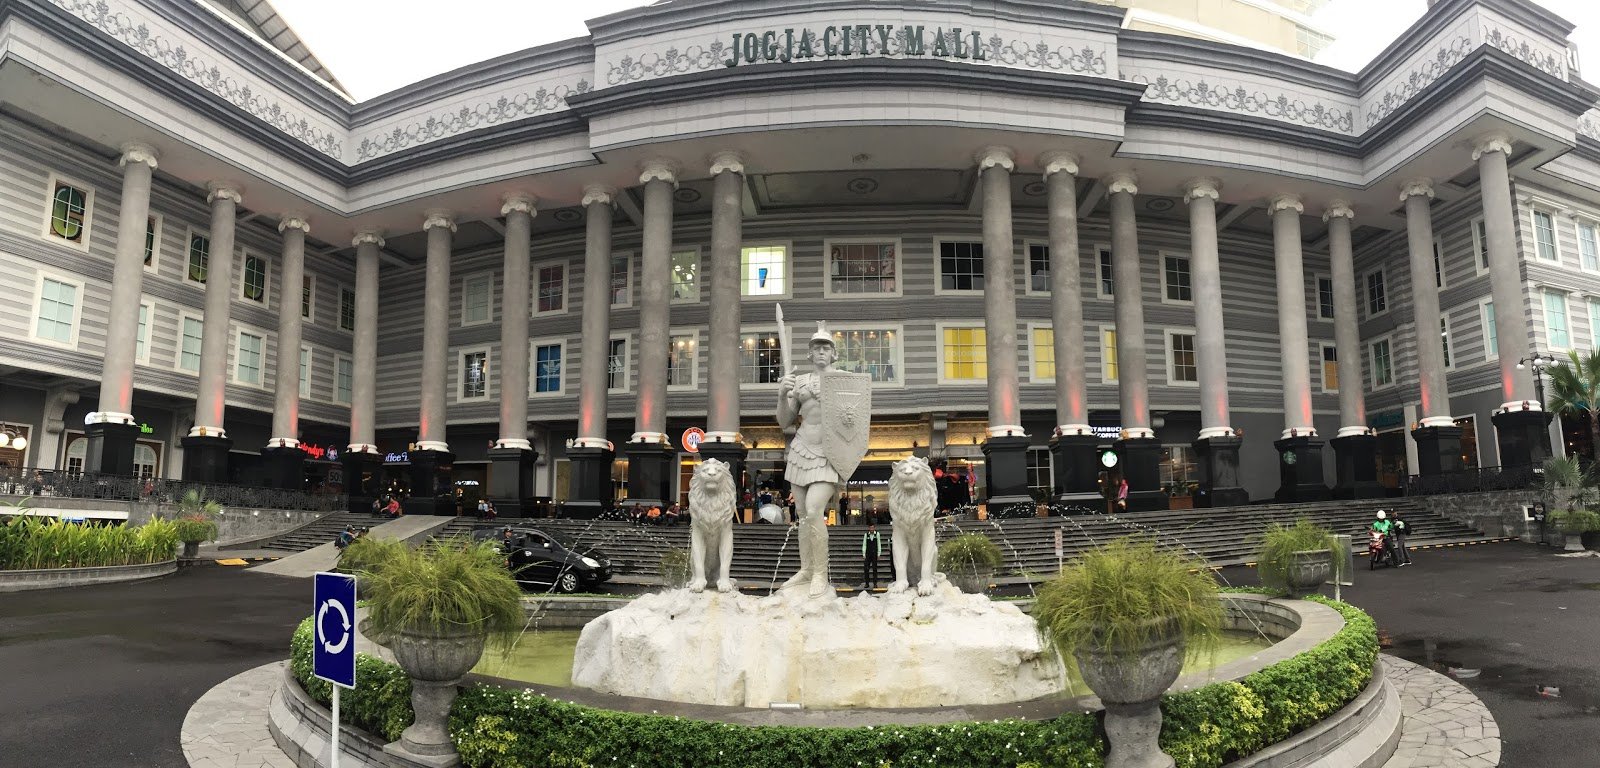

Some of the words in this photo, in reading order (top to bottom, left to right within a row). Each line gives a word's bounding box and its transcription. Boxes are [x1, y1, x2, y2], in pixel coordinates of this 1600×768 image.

[725, 27, 814, 68] JOGJA
[823, 24, 894, 57] CITY
[904, 25, 986, 61] MALL
